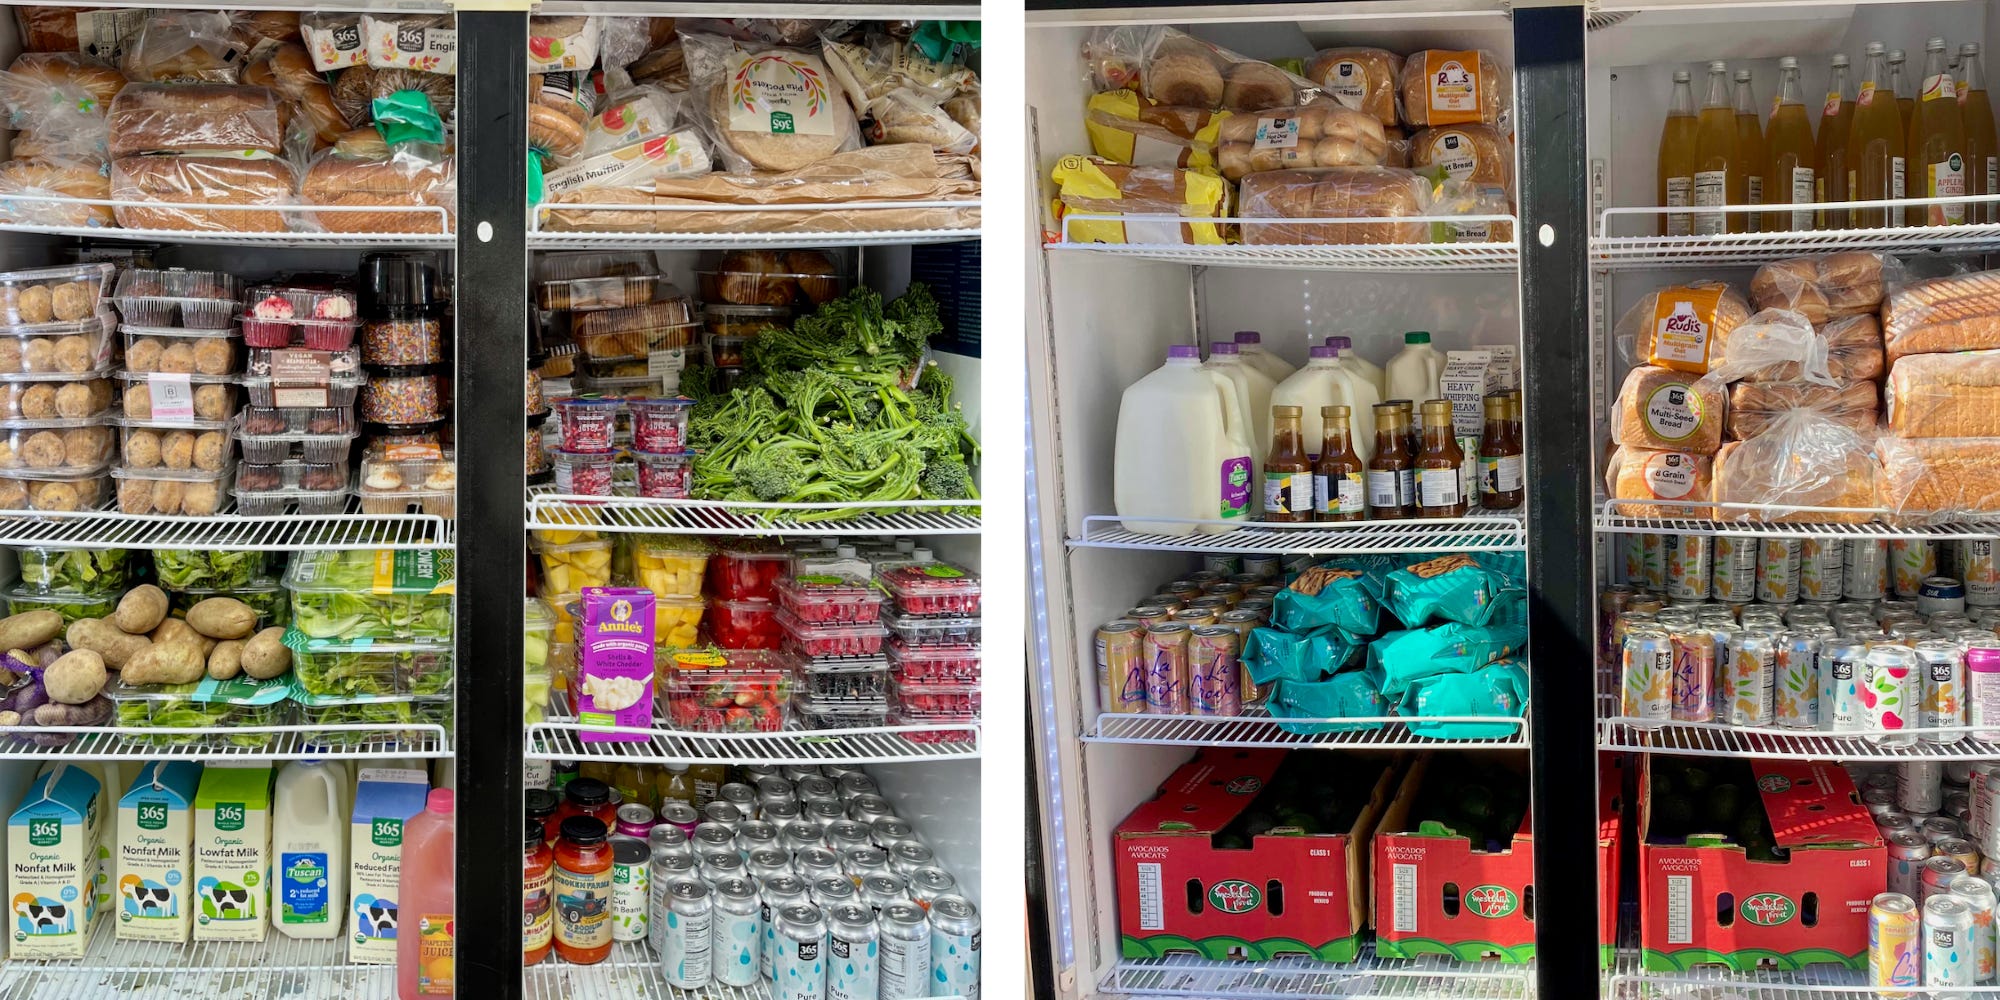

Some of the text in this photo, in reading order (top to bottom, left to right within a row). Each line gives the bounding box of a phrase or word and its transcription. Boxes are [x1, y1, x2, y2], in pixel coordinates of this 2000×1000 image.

[335, 29, 357, 42] 365
[399, 30, 423, 44] 365
[429, 41, 456, 52] Engli
[752, 80, 804, 92] Pita Pockets
[772, 119, 792, 130] 365
[1452, 160, 1473, 170] Bread
[548, 161, 625, 191] English Muffins
[1665, 317, 1701, 333] Rudi's
[1663, 340, 1699, 350] Multigrain
[1447, 383, 1475, 391] HEAVY
[1442, 392, 1480, 401] WHIPPING
[1453, 403, 1476, 411] REAM
[1651, 408, 1694, 423] Multi-Seed
[1659, 418, 1682, 429] Bread
[1662, 470, 1685, 479] Grain
[417, 548, 434, 579] OWERY
[599, 621, 643, 633] Annie's
[1833, 664, 1851, 674] 365
[1932, 666, 1951, 676] 365
[1832, 713, 1852, 722] Pure
[1927, 715, 1955, 727] Ginger
[140, 806, 165, 820] 365
[217, 806, 242, 821] 365
[32, 822, 58, 837] 365
[374, 821, 400, 837] 365
[137, 834, 166, 846] Organic
[214, 836, 244, 847] Organic
[122, 845, 181, 856] Nonfat Milk
[200, 847, 259, 857] Lowfat Milk
[1309, 849, 1325, 857] CLASS
[1384, 846, 1426, 854] AVOCADOS
[30, 852, 60, 863] Organic
[372, 852, 400, 863] Organic
[1387, 853, 1423, 861] AVOCATS
[1658, 857, 1702, 866] AVOCADOS
[15, 863, 76, 873] Nonfat Milk
[288, 867, 322, 877] Tuscan
[354, 862, 387, 871] Reduced
[555, 875, 586, 889] HOBOKEN
[613, 896, 626, 905] Cut
[620, 906, 642, 914] Beans
[1934, 931, 1952, 943] 365
[799, 945, 817, 954] 365
[832, 940, 849, 953] 365
[1933, 976, 1954, 987] Pure
[830, 985, 849, 999] Pure
